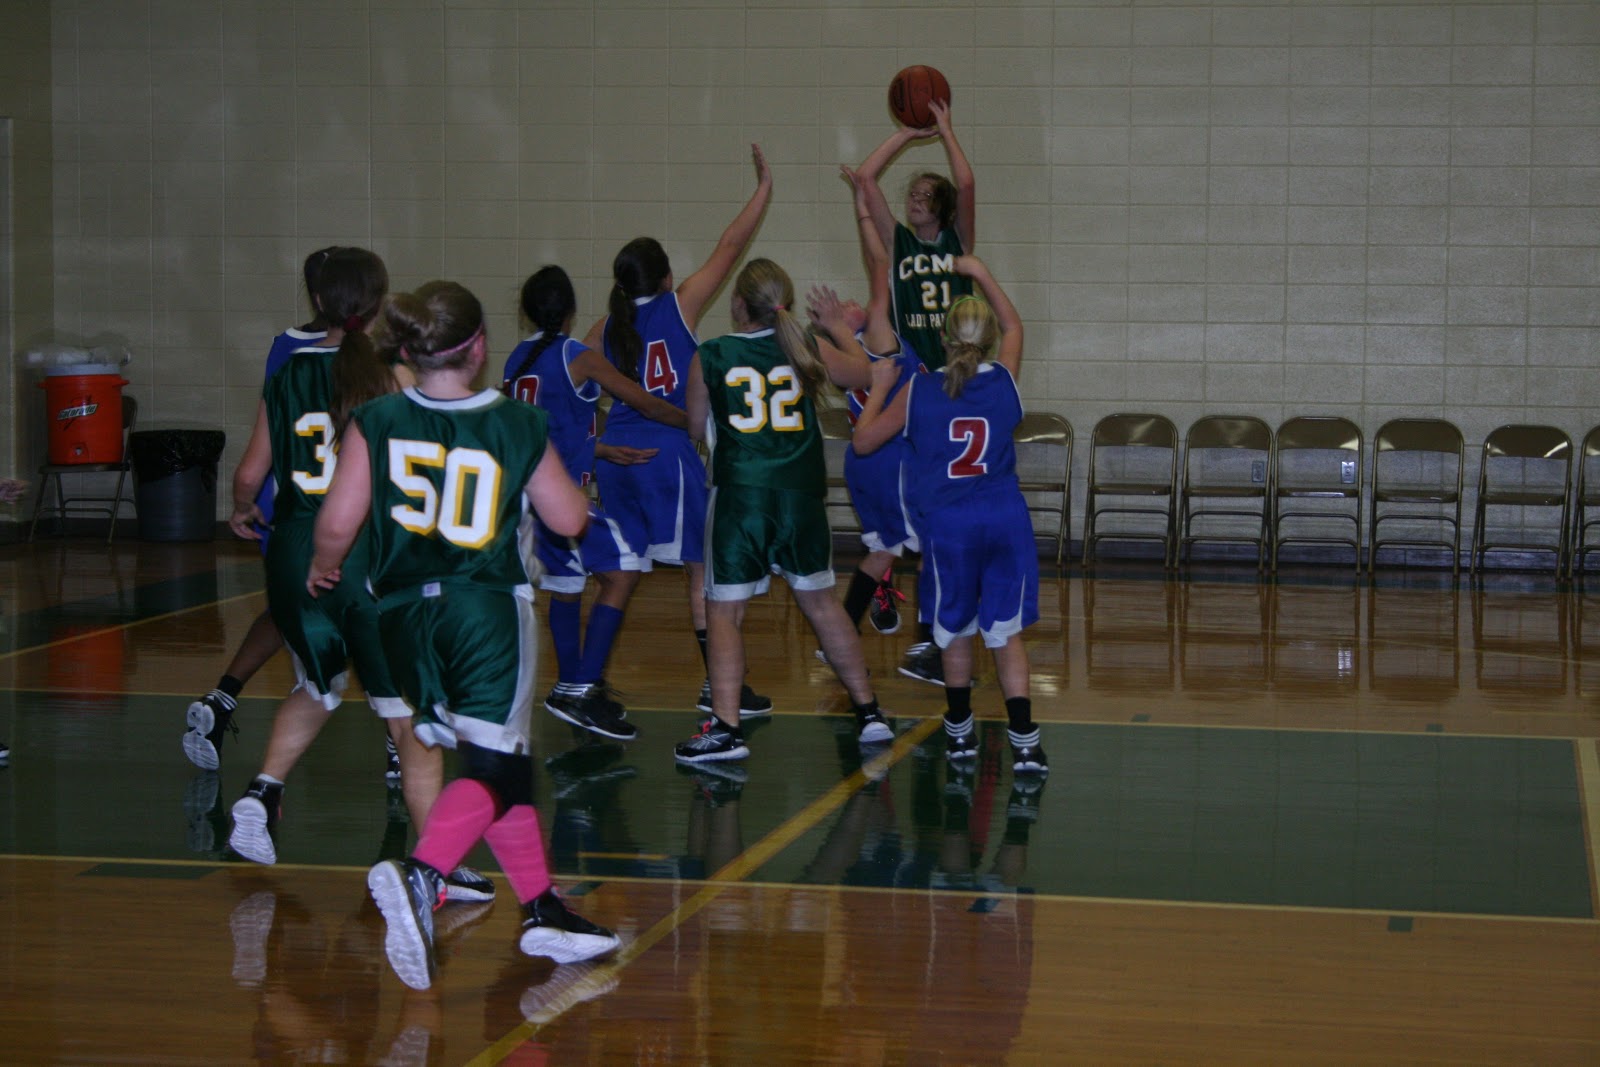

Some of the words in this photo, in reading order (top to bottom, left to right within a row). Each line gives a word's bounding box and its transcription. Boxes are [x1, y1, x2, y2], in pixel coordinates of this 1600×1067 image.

[921, 281, 950, 309] 21
[644, 340, 677, 396] 4
[725, 365, 804, 433] 32
[948, 417, 990, 478] 2
[388, 438, 502, 549] 50
